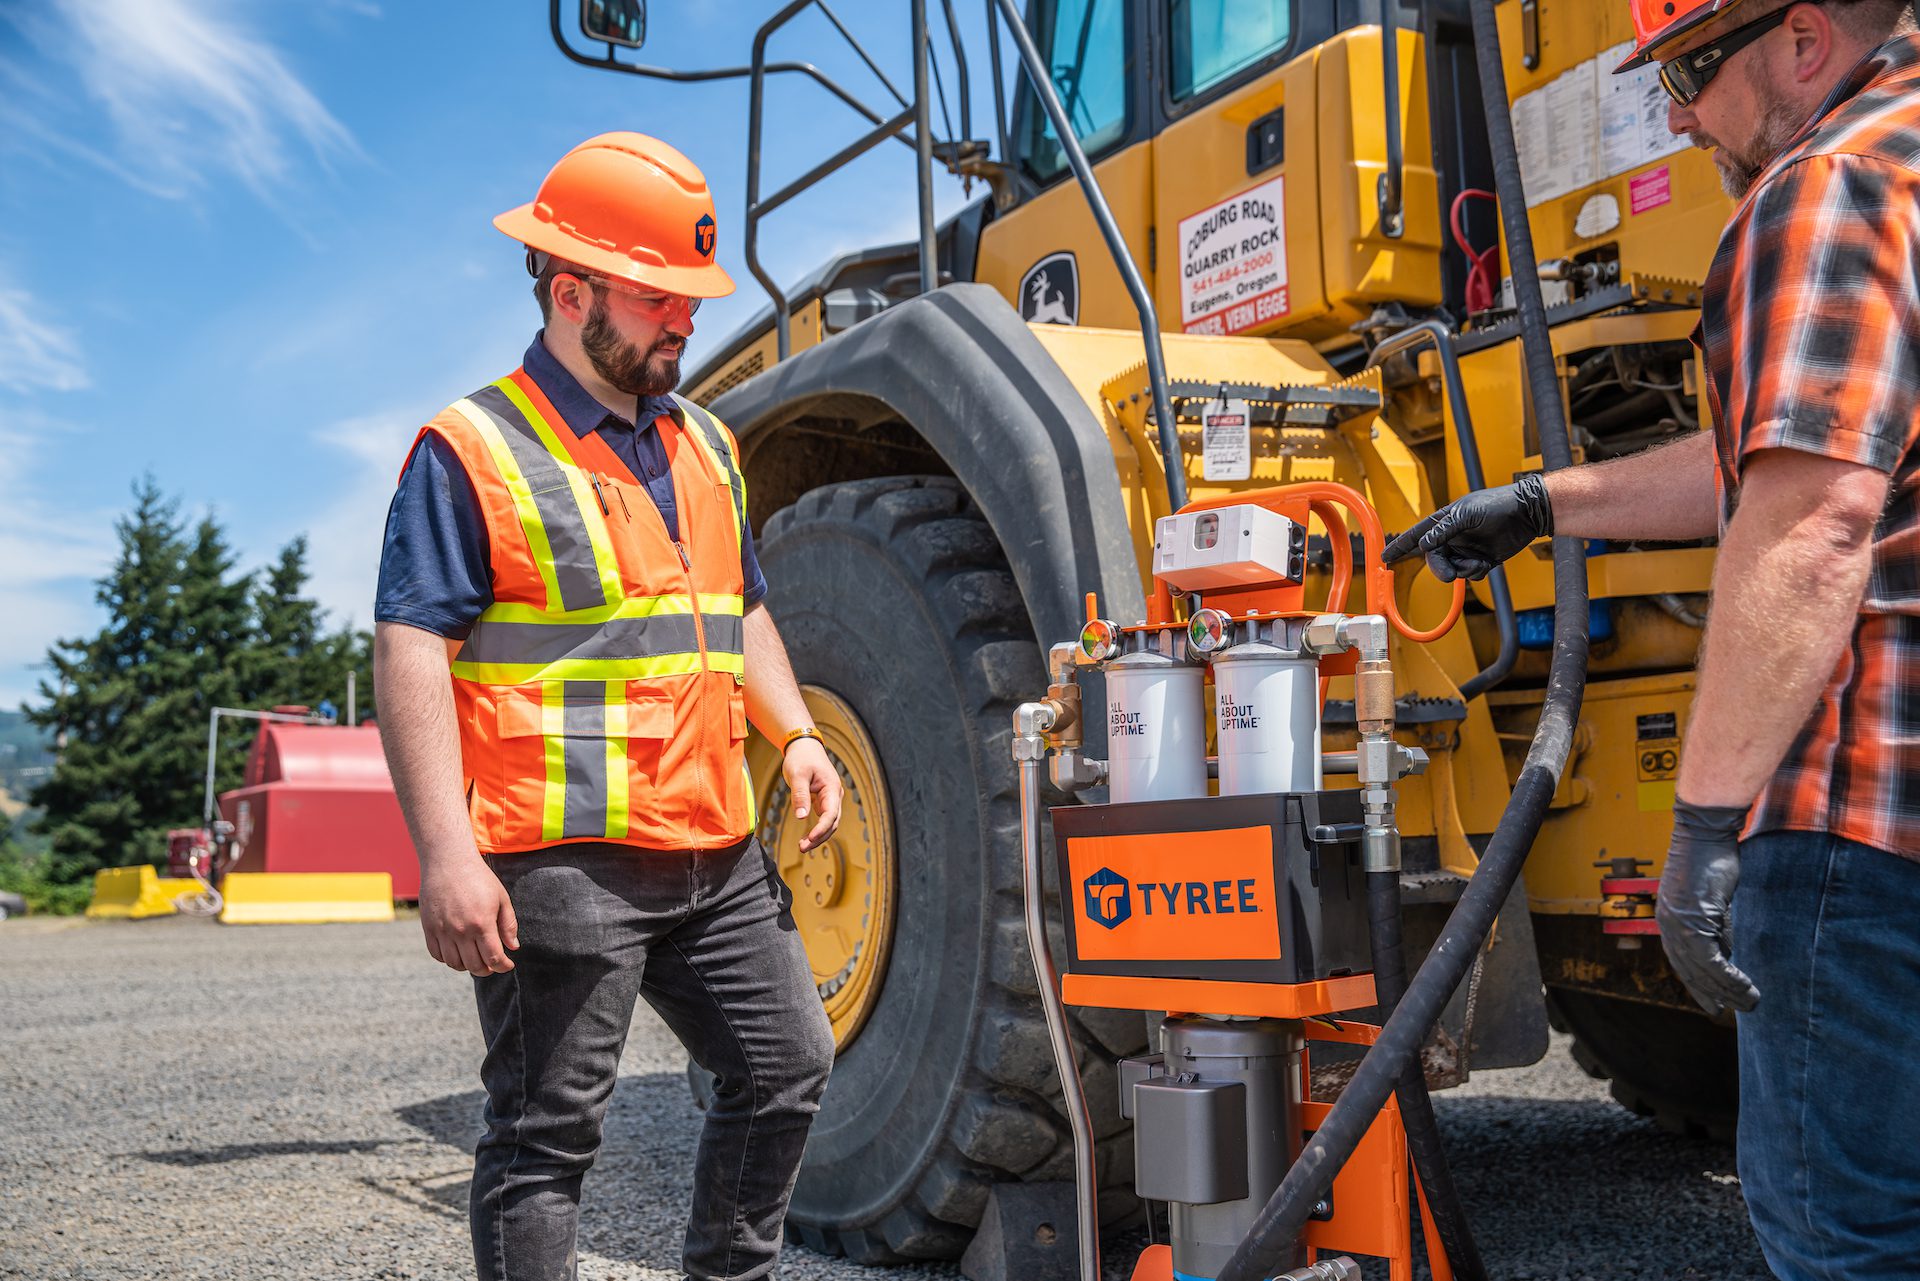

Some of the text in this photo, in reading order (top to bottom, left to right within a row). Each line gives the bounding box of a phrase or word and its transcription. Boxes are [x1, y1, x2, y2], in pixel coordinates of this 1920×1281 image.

[1187, 200, 1275, 259] COBURG ROAD
[1184, 226, 1280, 278] QUARRY ROCK
[1190, 272, 1278, 314] Eugene, Oregon
[1225, 301, 1256, 332] VERN
[1256, 289, 1287, 321] EGGE
[1110, 712, 1141, 725] ABOUT
[1220, 694, 1234, 706] ALL
[1220, 705, 1254, 718] ABOUT
[1136, 878, 1258, 916] TYREE
